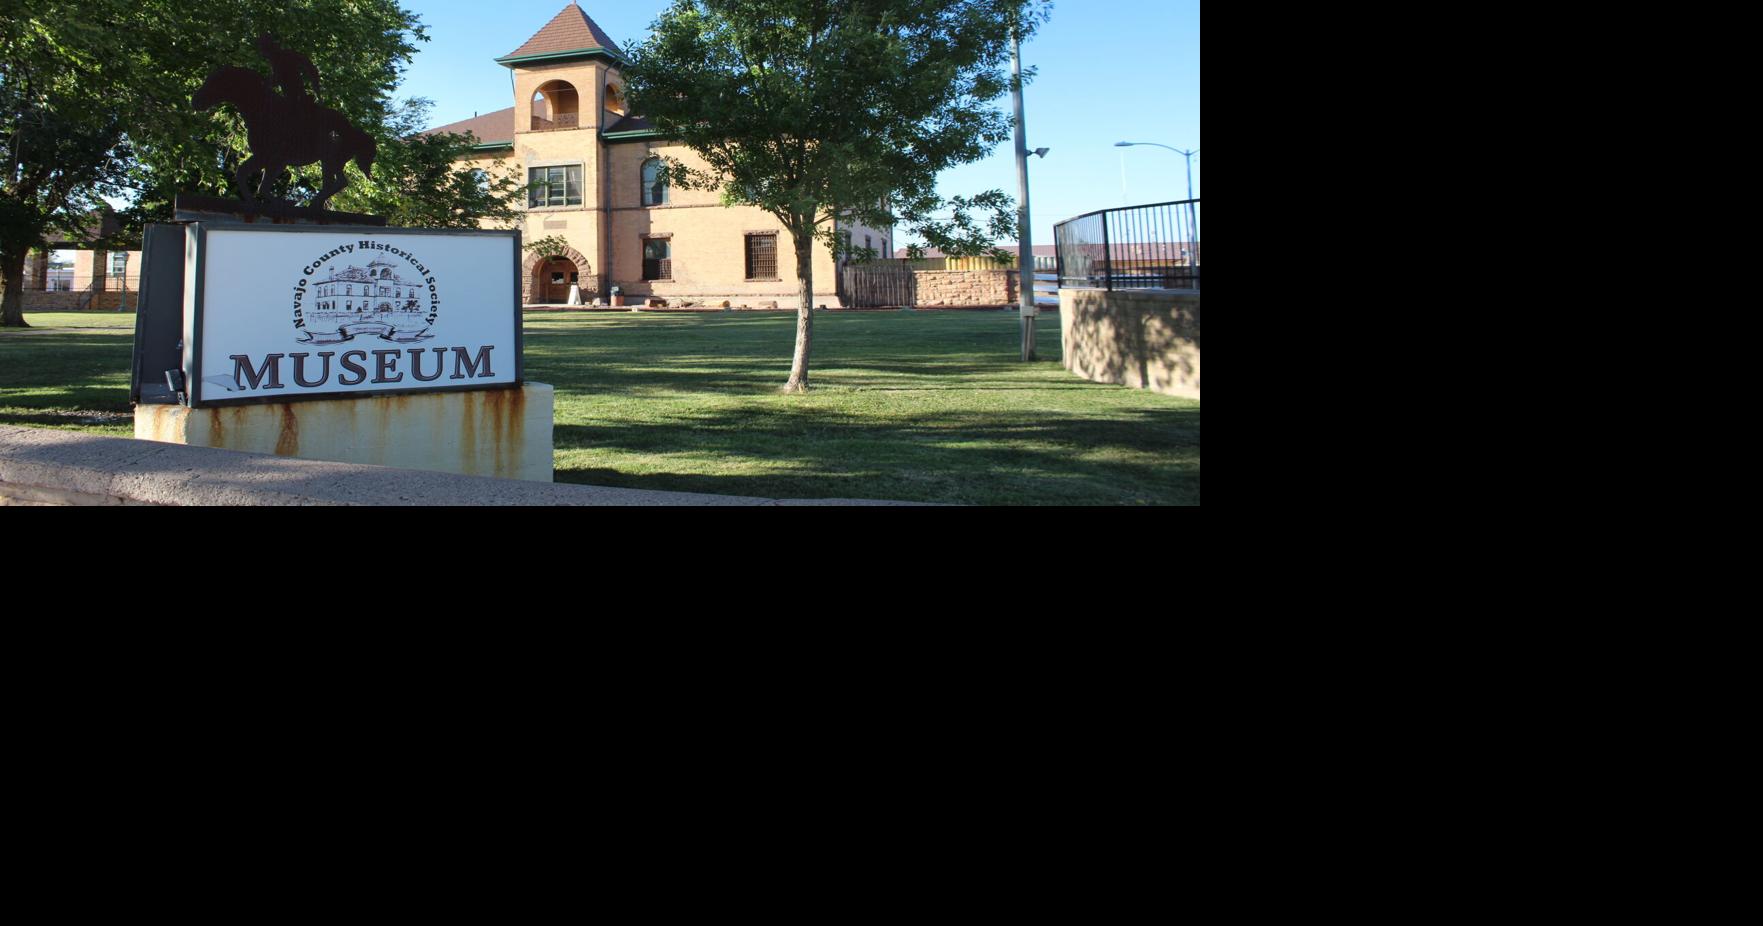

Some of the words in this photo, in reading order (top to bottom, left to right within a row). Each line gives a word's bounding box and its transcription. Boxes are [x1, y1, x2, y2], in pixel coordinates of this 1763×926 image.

[293, 278, 307, 329] Navajo
[303, 243, 355, 276] County
[358, 240, 430, 276] Historical
[425, 276, 440, 326] Society
[229, 345, 496, 391] MUSEUM
